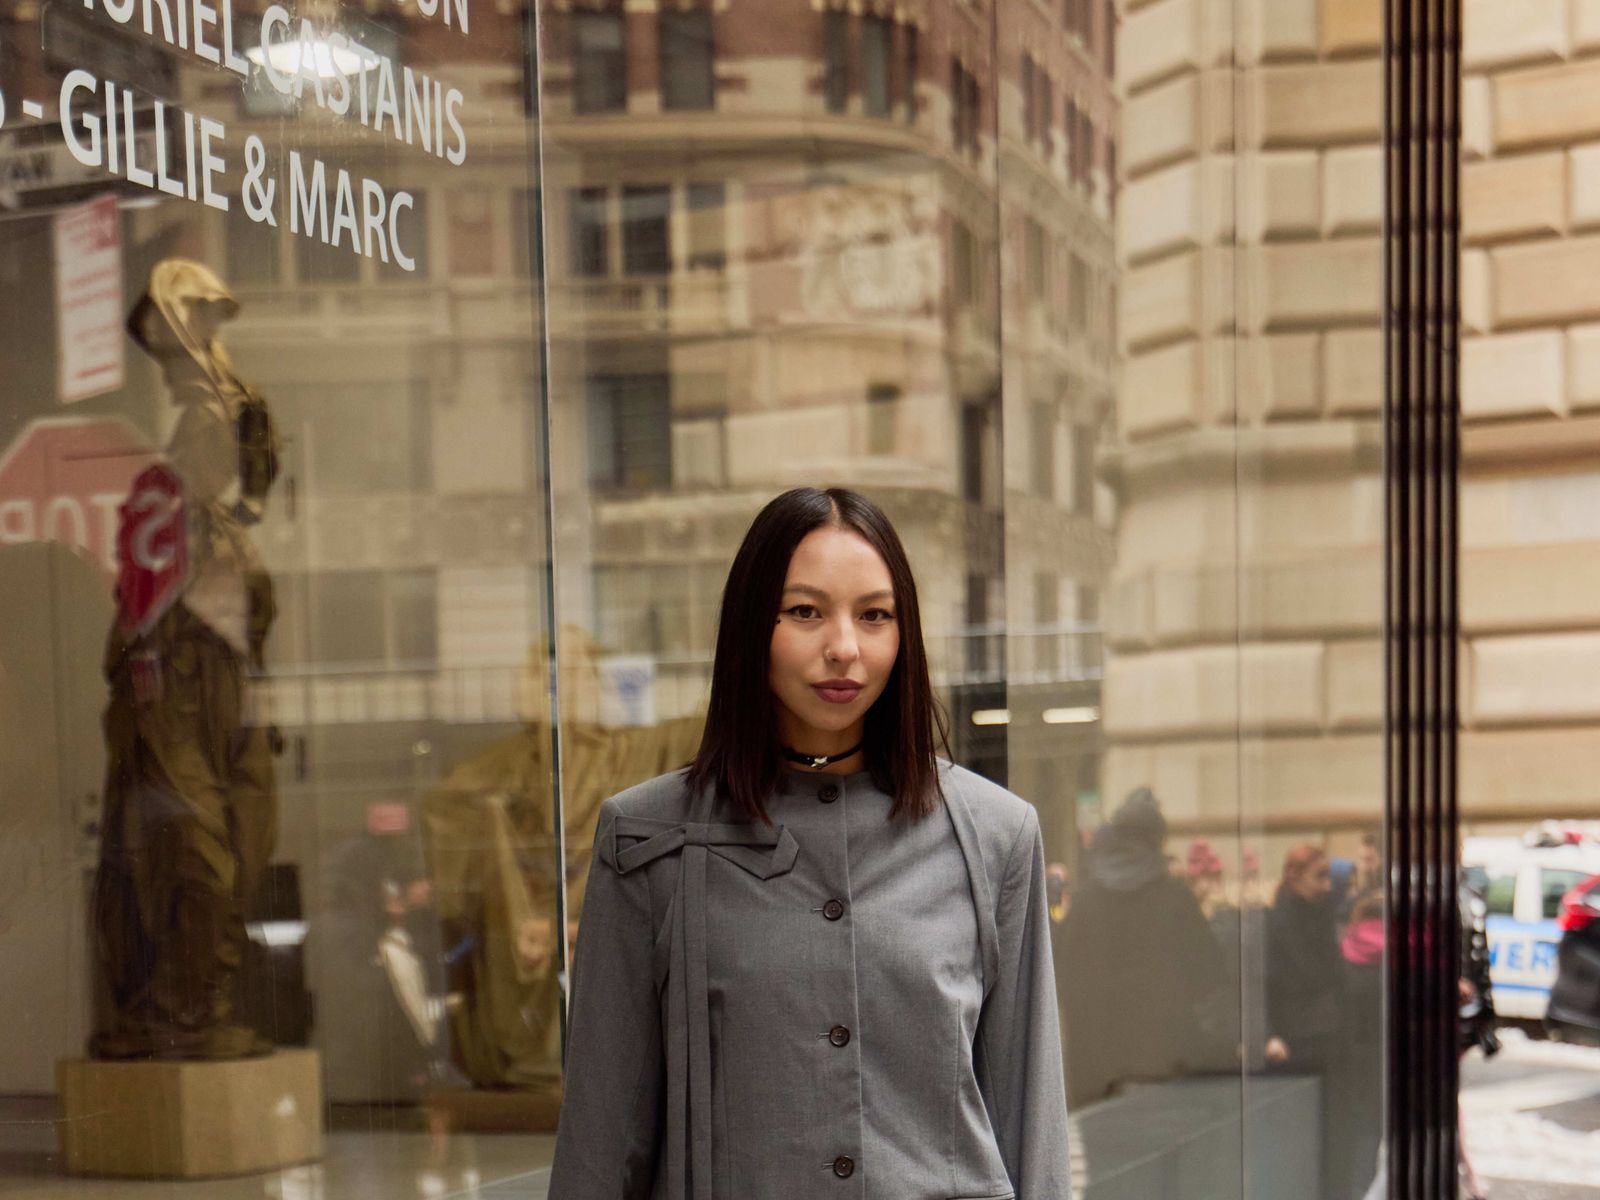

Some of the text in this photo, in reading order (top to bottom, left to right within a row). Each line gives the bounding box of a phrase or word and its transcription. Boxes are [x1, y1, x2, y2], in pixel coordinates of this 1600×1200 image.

[59, 69, 229, 212] GILLIE
[241, 134, 278, 227] &
[289, 150, 416, 271] MARC
[83, 0, 467, 166] IEL CASTANIS
